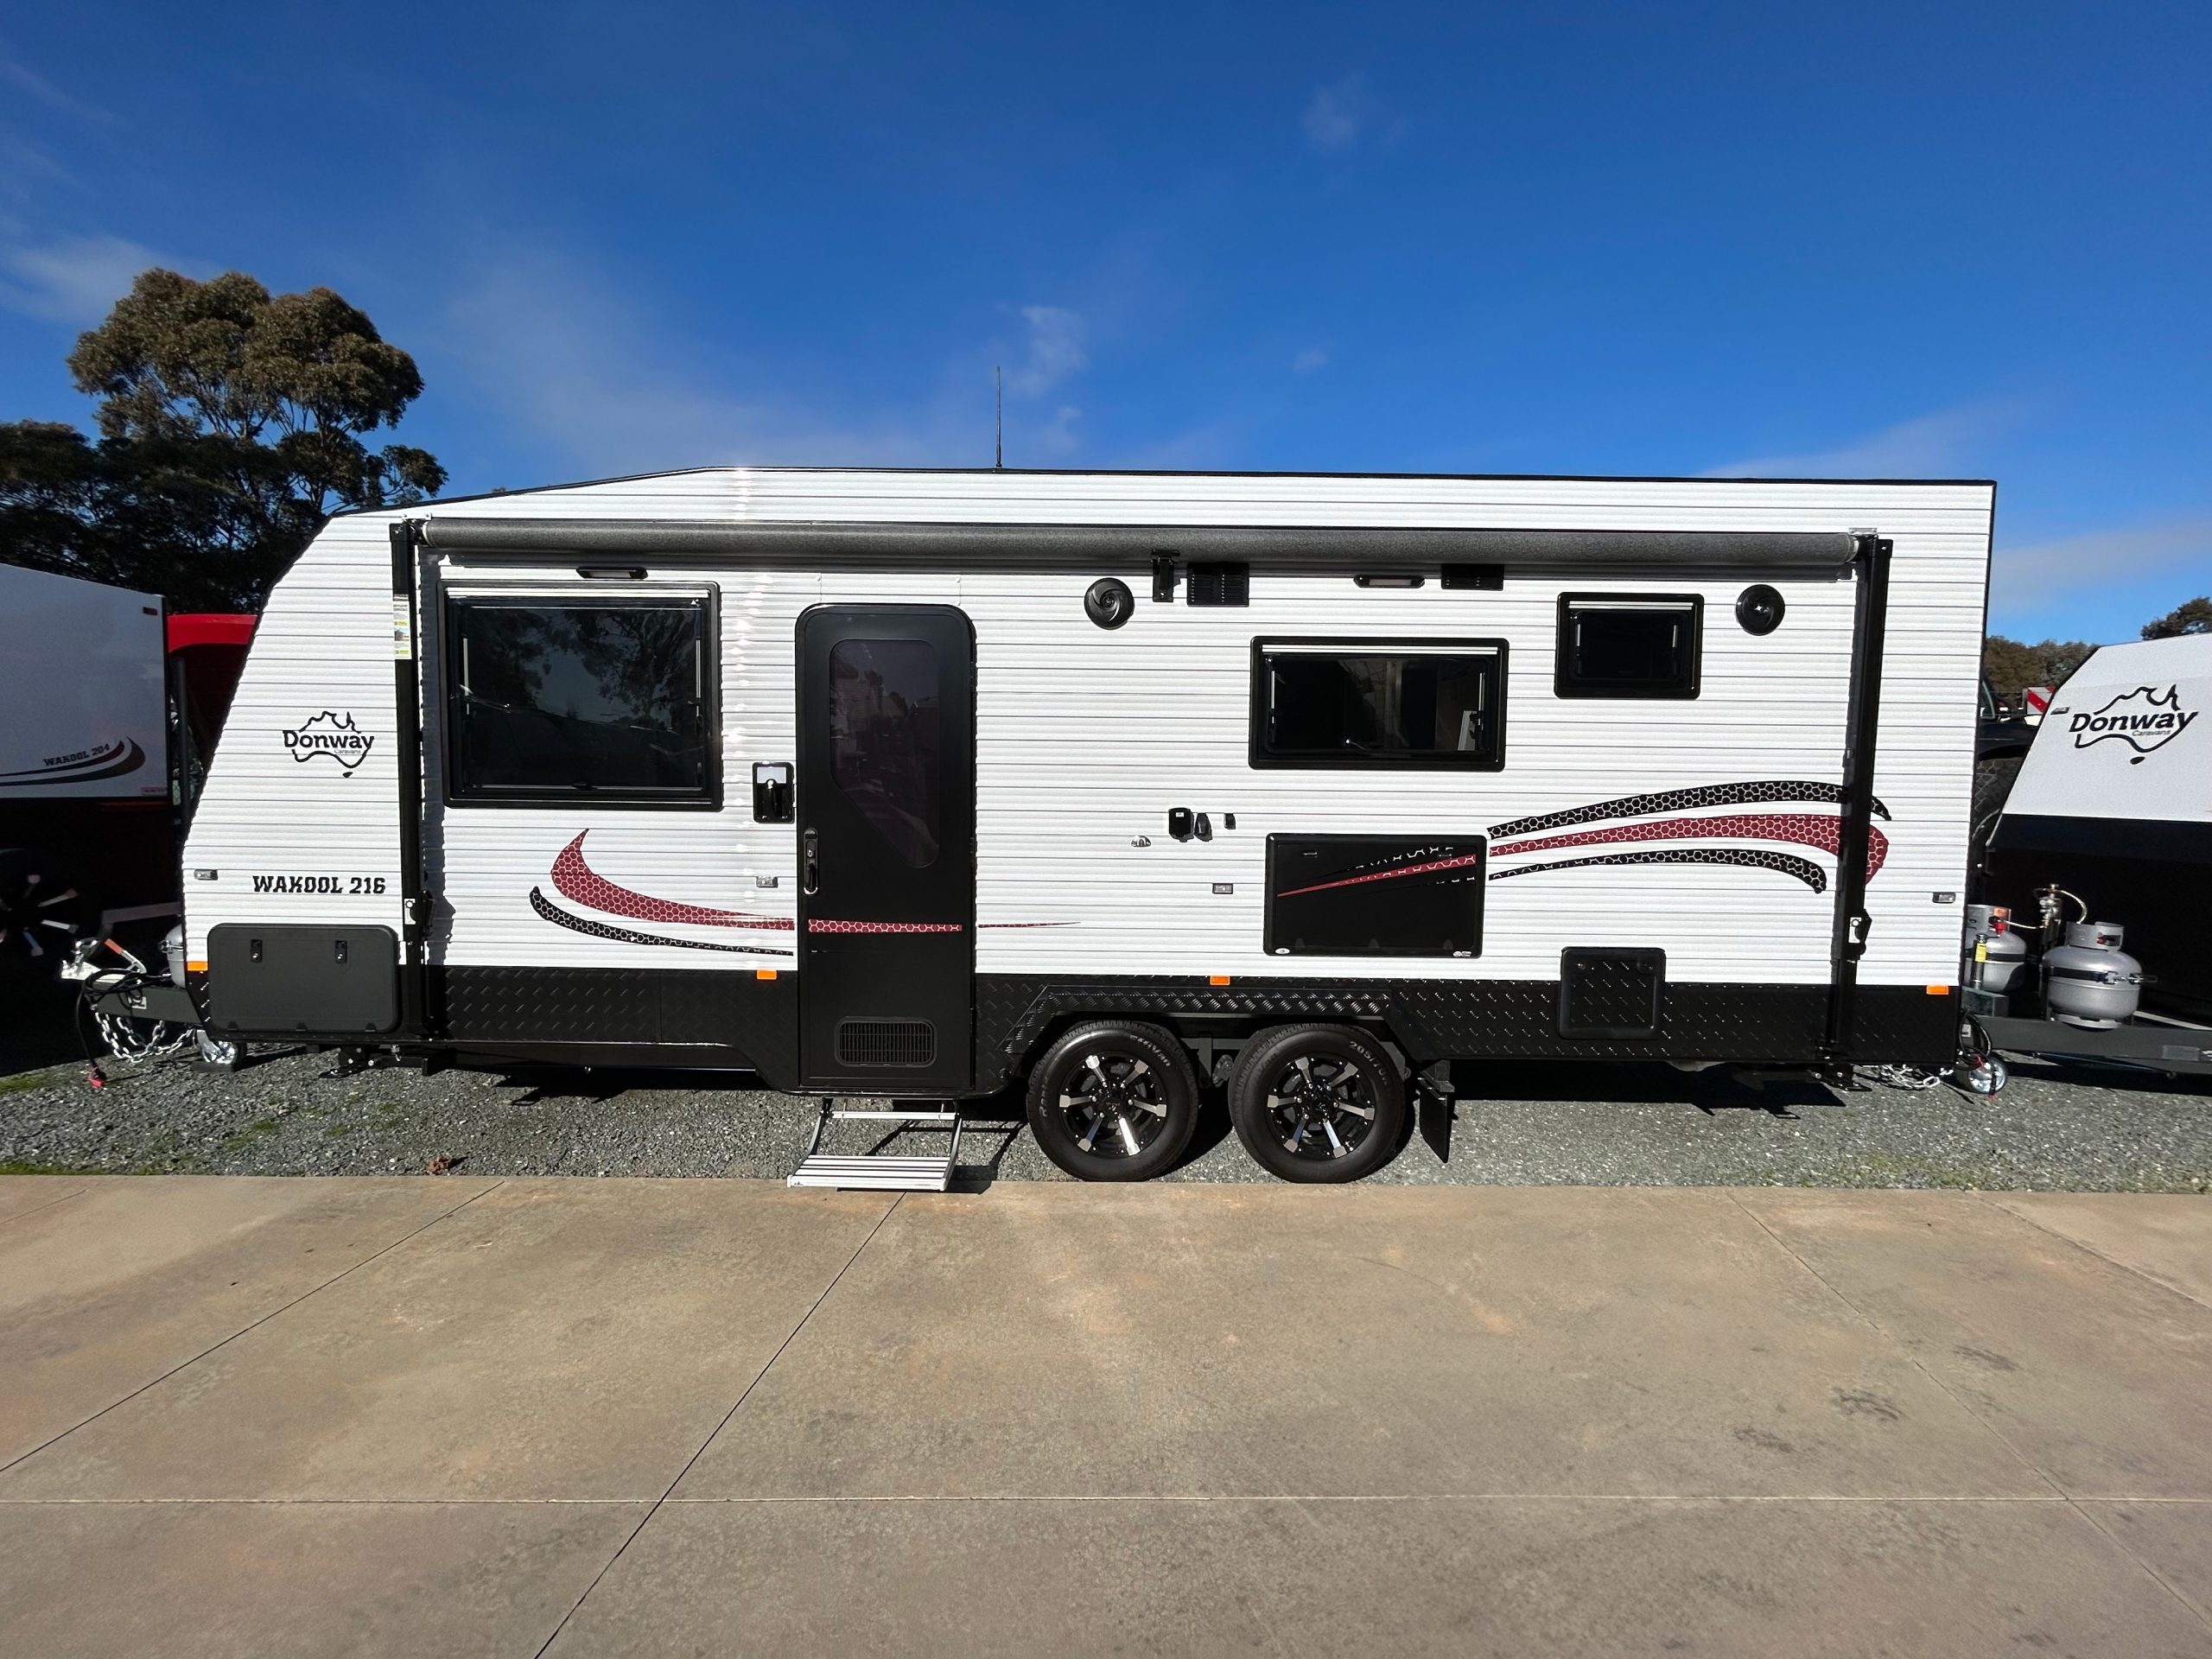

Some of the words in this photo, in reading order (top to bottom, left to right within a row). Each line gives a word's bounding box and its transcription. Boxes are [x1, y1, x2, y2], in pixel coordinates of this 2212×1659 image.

[2069, 711, 2199, 734] Donway
[283, 730, 374, 749] Donway
[43, 750, 90, 766] WAKOOL
[92, 743, 110, 756] 204
[252, 875, 343, 893] WAKOOL
[349, 877, 386, 894] 216
